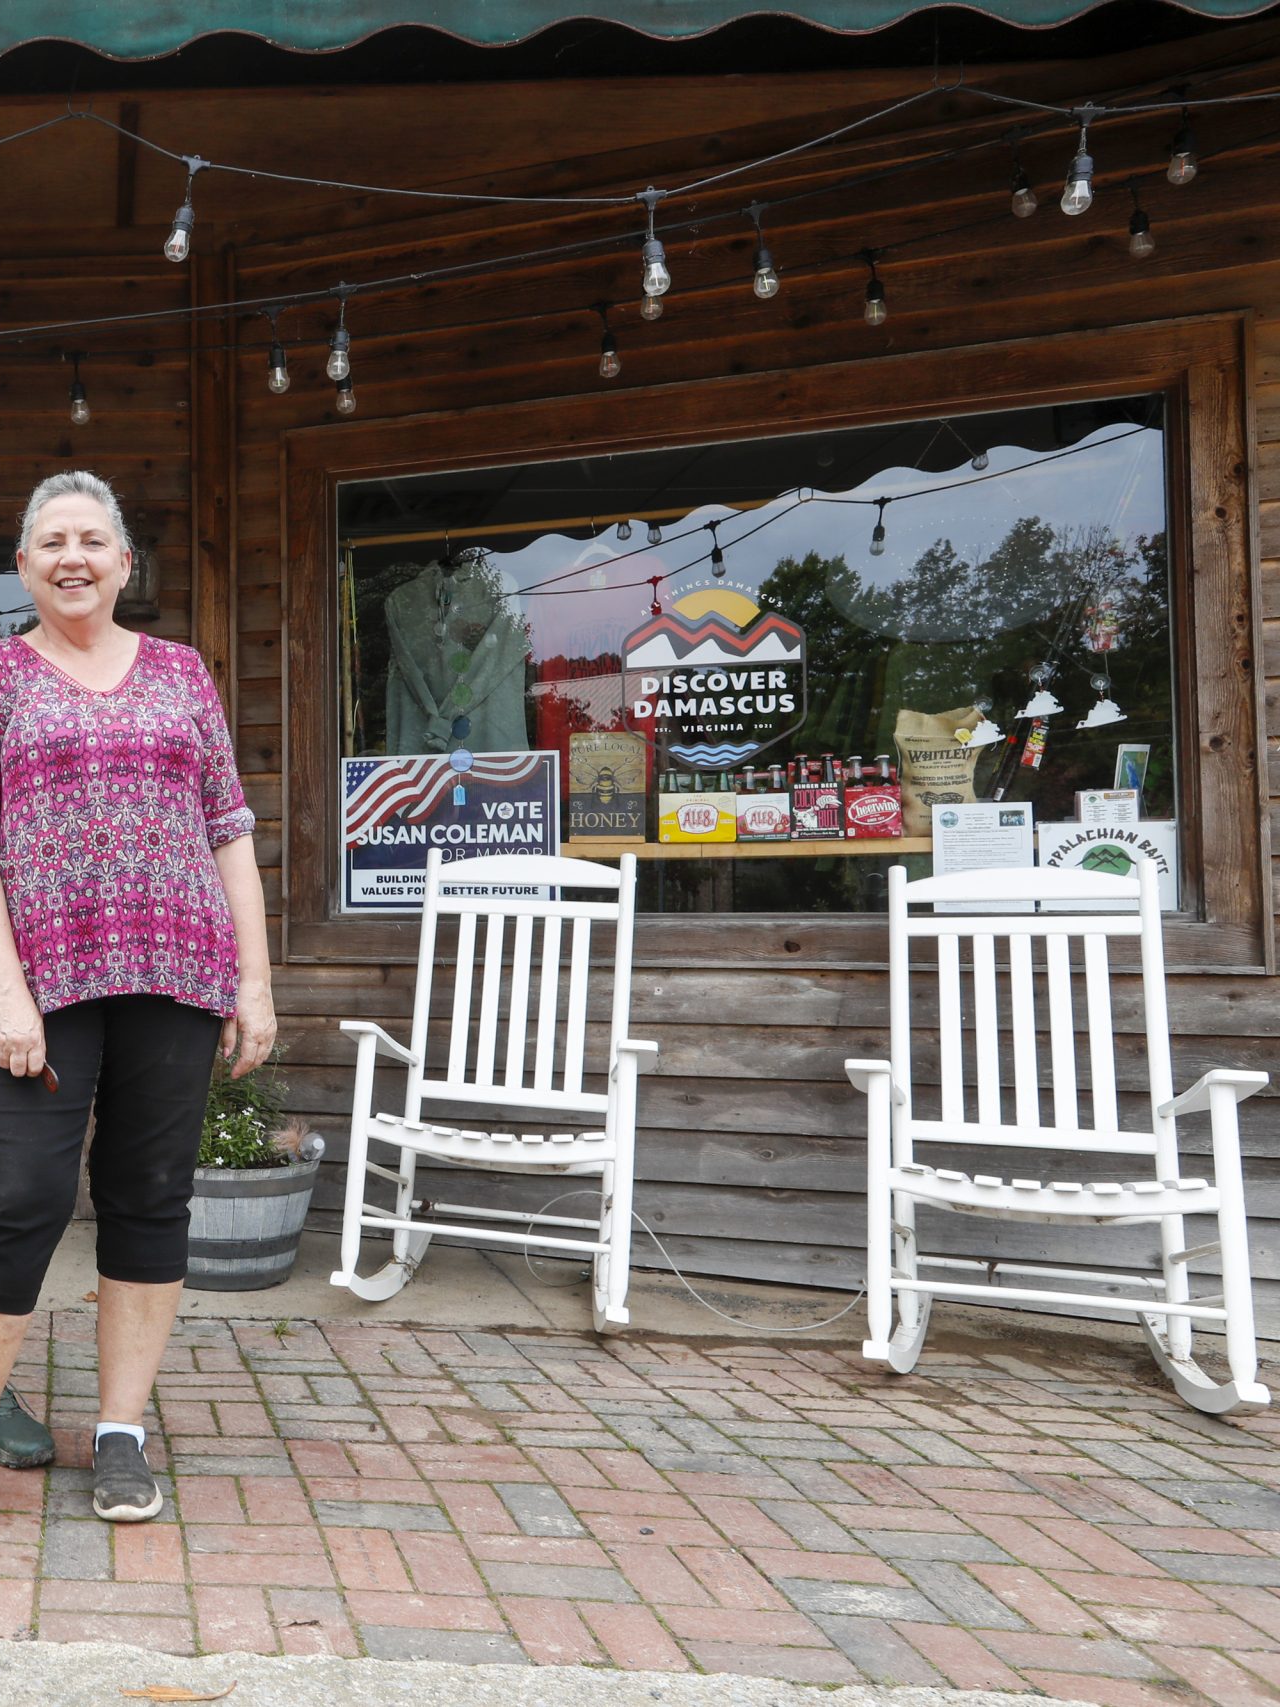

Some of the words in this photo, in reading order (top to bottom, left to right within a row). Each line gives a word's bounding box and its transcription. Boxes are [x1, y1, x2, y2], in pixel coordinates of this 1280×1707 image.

[640, 601, 661, 617] ALL
[664, 579, 710, 601] THINGS
[717, 579, 784, 608] DAMASCUS
[641, 670, 787, 695] DISCOVER
[634, 694, 795, 718] DAMASCUS
[682, 723, 744, 733] VIRGINIA
[571, 743, 600, 756] PURE
[604, 742, 641, 755] LOCAL
[481, 801, 543, 819] VOTE
[818, 809, 840, 828] BULL
[848, 800, 900, 820] Cheerwine
[569, 812, 641, 828] HONEY
[356, 825, 426, 845] SUSAN
[430, 823, 543, 844] COLEMAN
[441, 848, 466, 863] OR
[1047, 827, 1138, 868] PPALACHIAN
[361, 886, 405, 895] VALUES
[443, 886, 489, 895] BETTER
[492, 886, 539, 895] FUTURE
